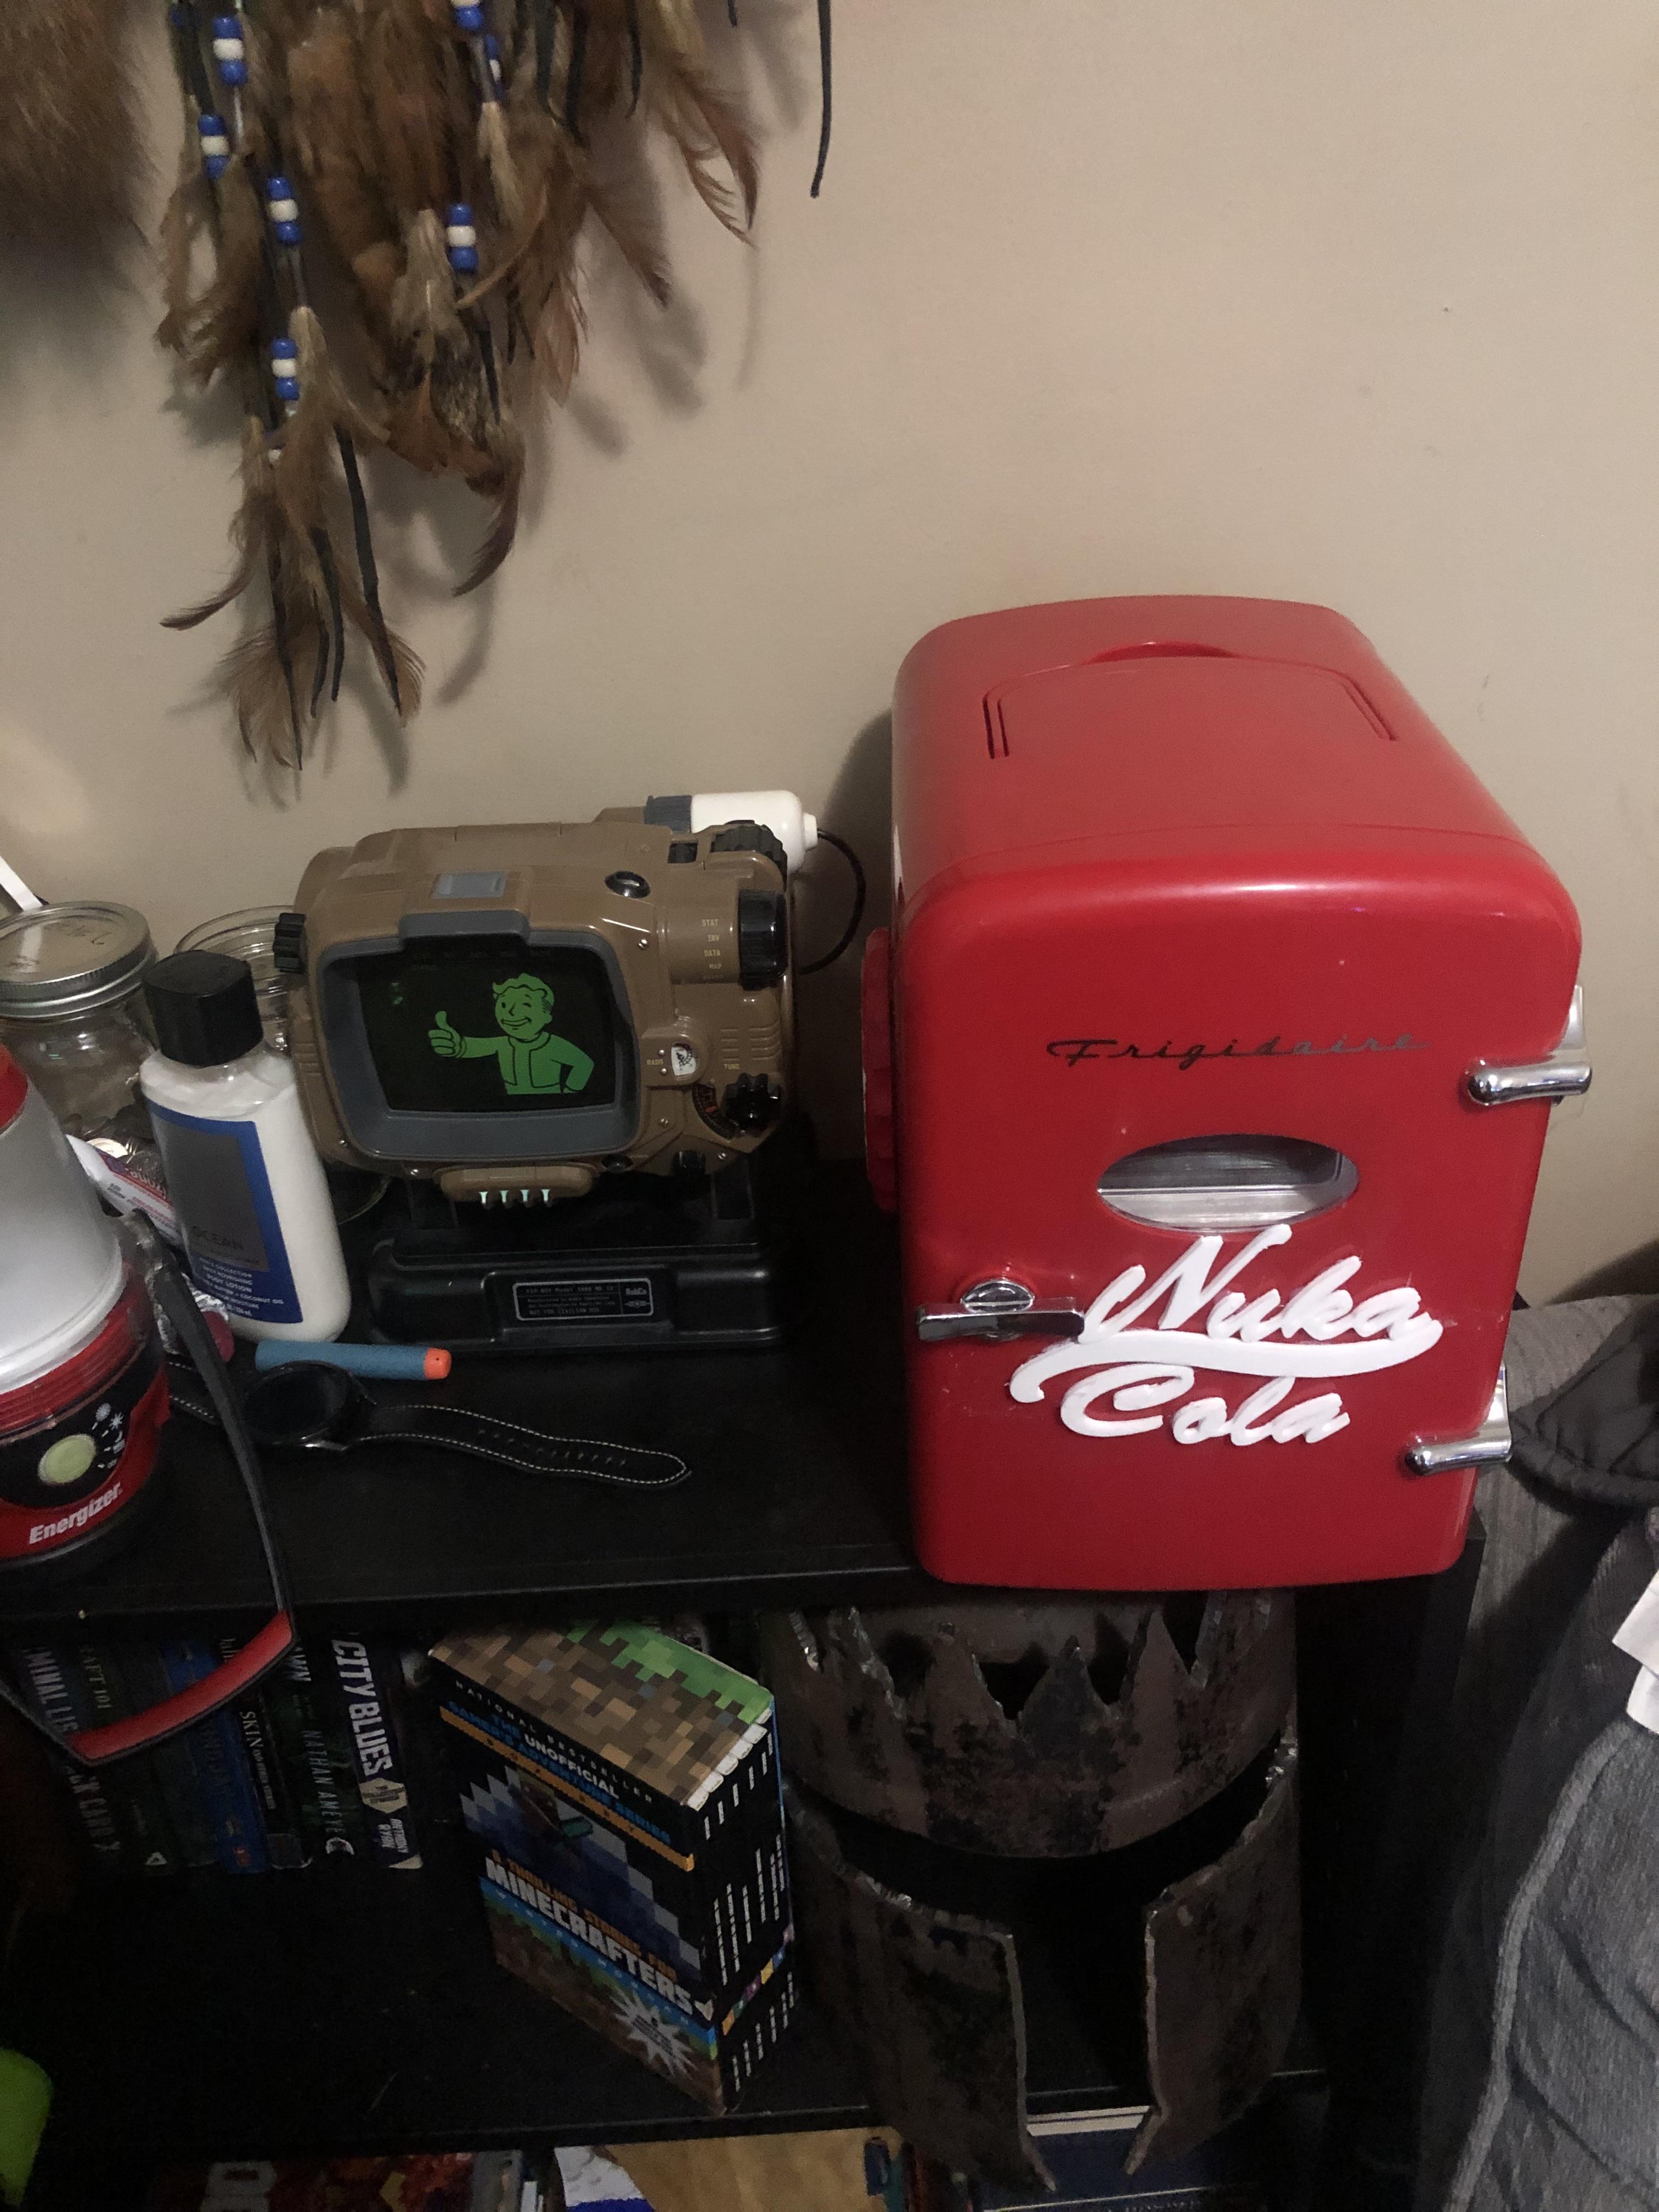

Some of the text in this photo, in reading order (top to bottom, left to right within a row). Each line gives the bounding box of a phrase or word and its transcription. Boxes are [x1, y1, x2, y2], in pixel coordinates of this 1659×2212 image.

[702, 918, 719, 927] STAT
[1047, 1032, 1428, 1070] Frigidaire
[225, 1280, 252, 1293] LOTION
[1008, 1223, 1443, 1378] Nuka
[1061, 1363, 1351, 1447] Cola
[29, 1481, 121, 1544] Energizer
[331, 1639, 377, 1697] CITY
[239, 1711, 264, 1747] SKIN
[301, 1730, 334, 1785] NATHAN
[349, 1701, 394, 1777] BLUES
[455, 1679, 653, 1804] NATIONAL BESTSELLER
[524, 1733, 620, 1800] UNOFFICIAL
[484, 1855, 693, 2016] MINECRAFTERS
